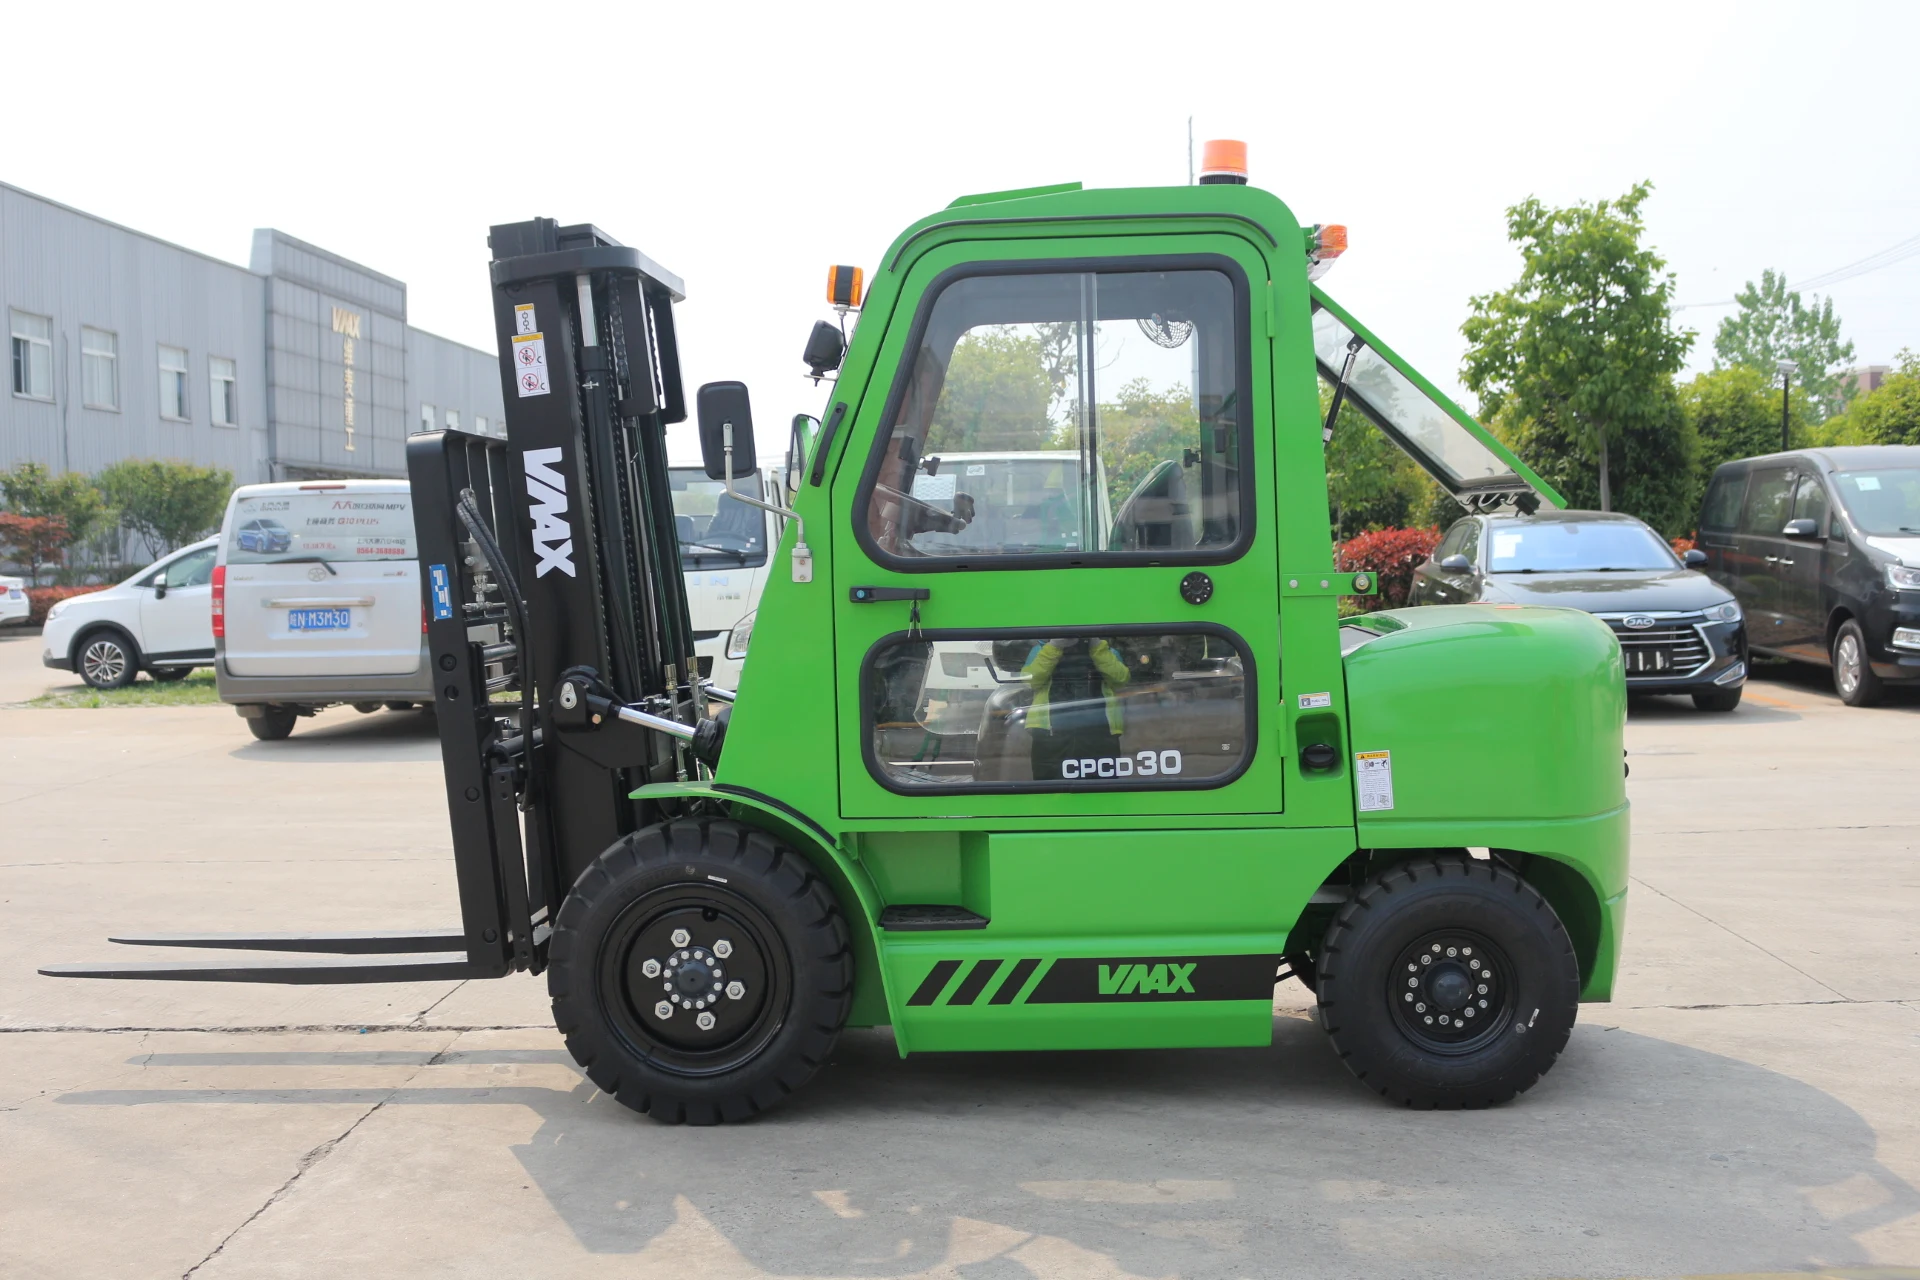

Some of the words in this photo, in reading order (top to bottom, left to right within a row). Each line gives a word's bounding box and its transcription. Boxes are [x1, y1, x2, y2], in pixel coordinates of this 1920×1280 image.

[332, 306, 361, 339] VMAX
[385, 503, 406, 511] MPV
[522, 446, 577, 579] VMAX
[1098, 963, 1198, 995] VMAX
